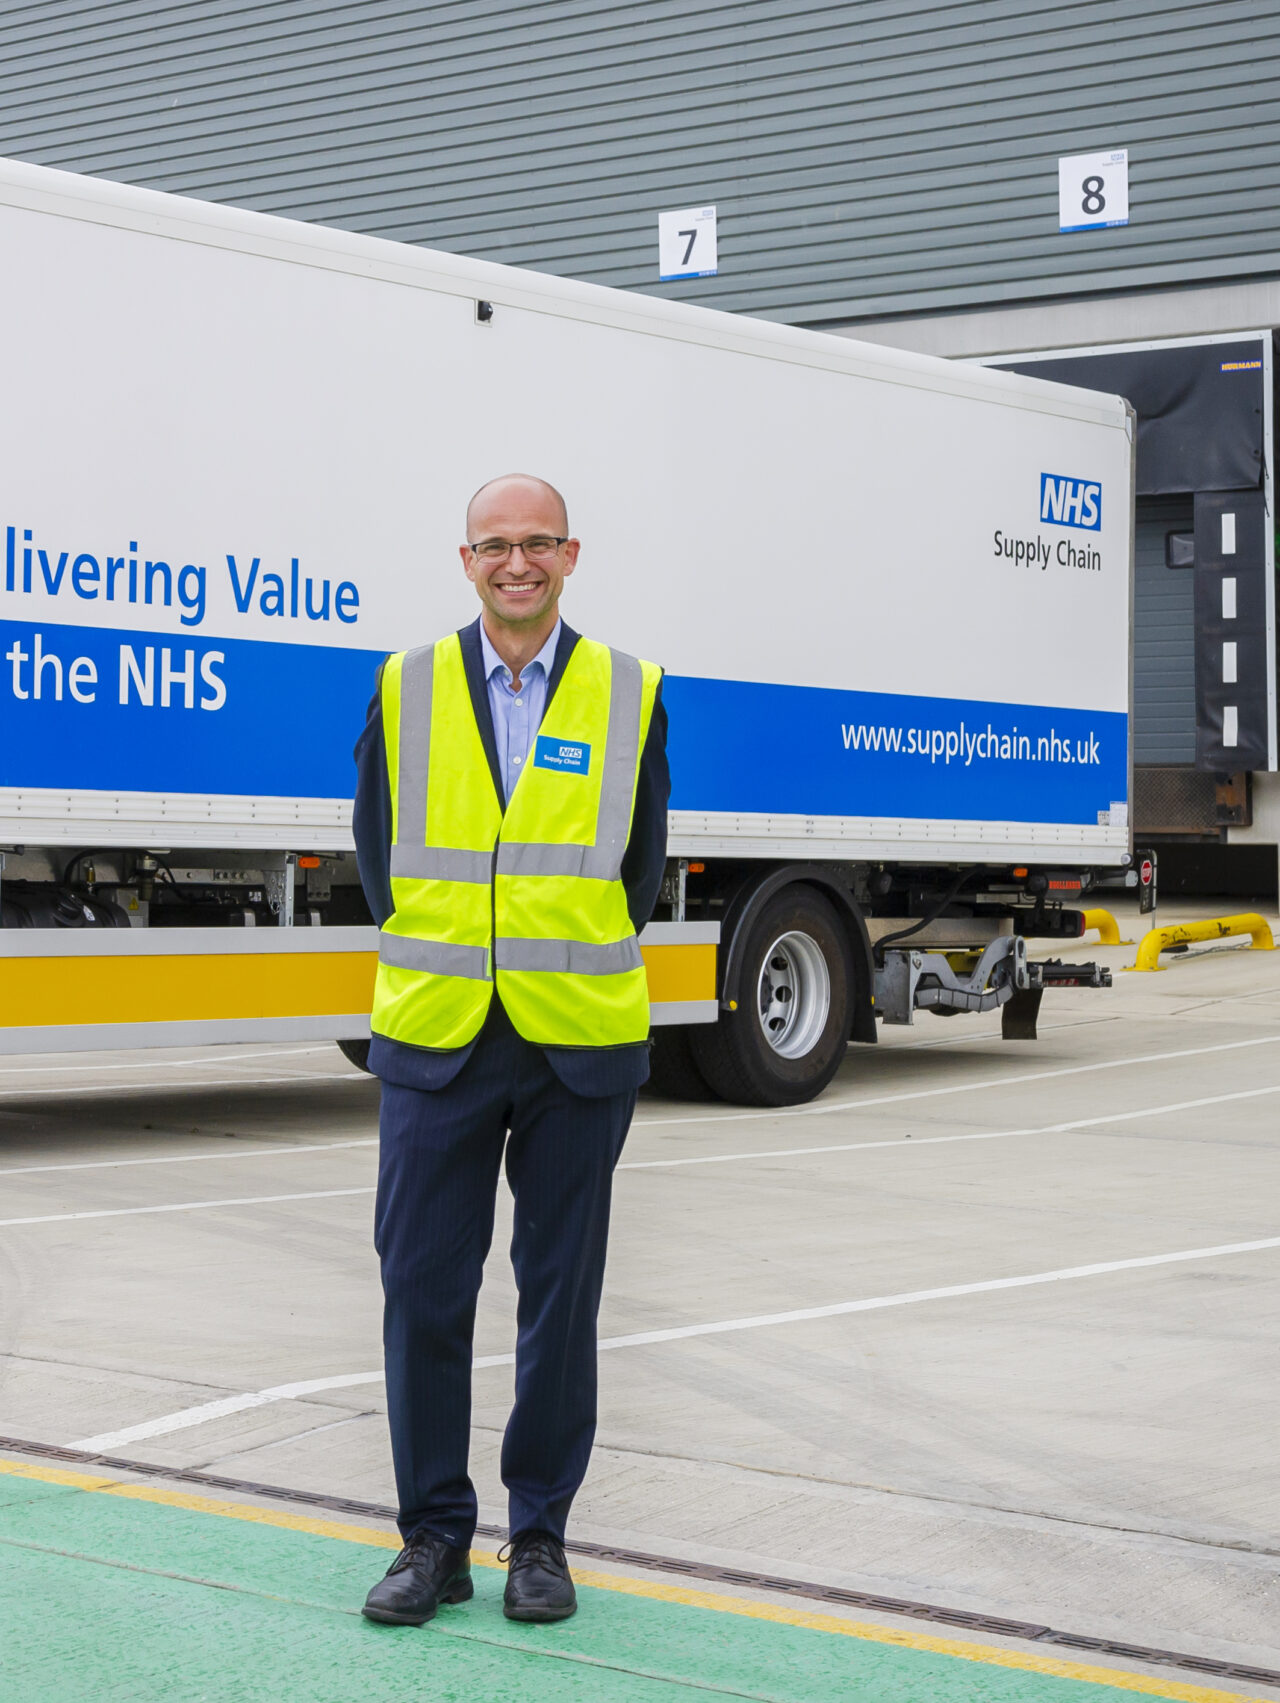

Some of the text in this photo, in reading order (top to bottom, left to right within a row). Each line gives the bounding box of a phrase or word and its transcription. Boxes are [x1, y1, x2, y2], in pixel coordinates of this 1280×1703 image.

[1081, 175, 1106, 216] 8
[678, 228, 698, 266] 7
[1041, 477, 1100, 527] NHS
[993, 529, 1102, 572] Supply Chain
[226, 554, 361, 624] Value
[5, 633, 98, 704] the
[118, 644, 227, 712] NHS
[559, 747, 582, 758] NHS
[841, 722, 1100, 766] www.supplychain.nhs.uk
